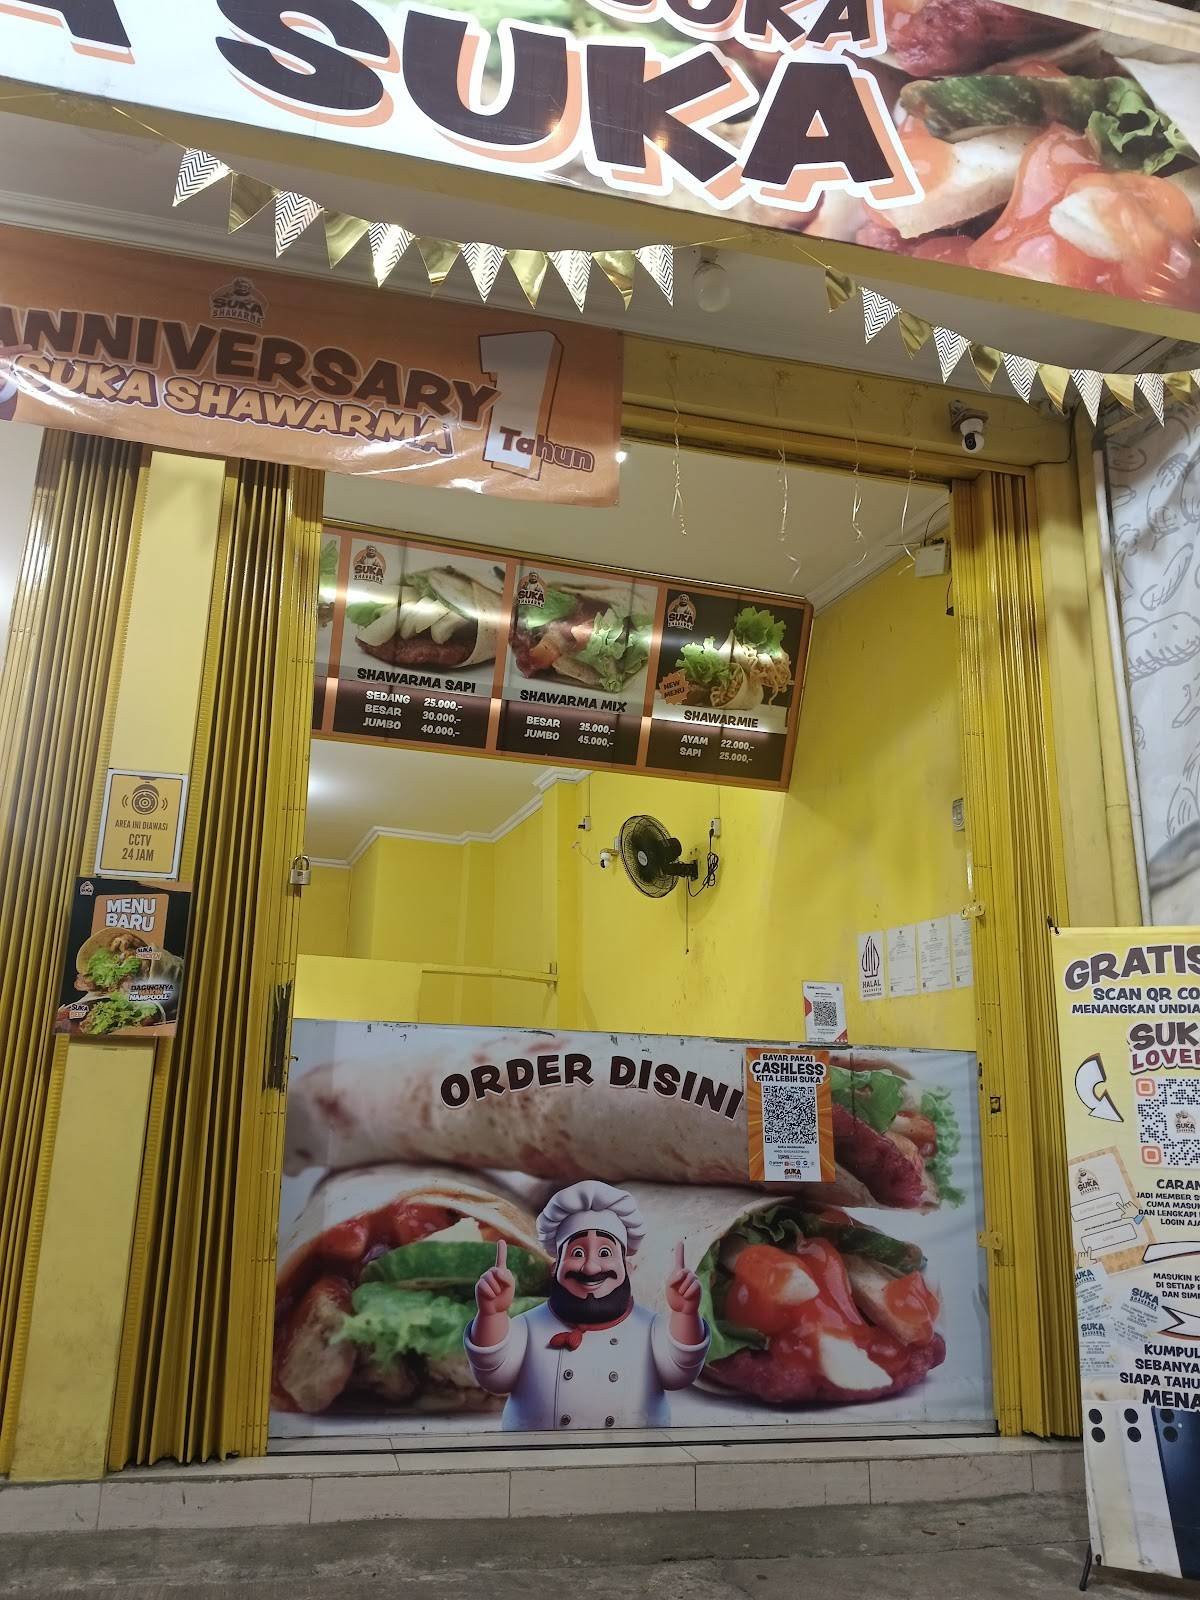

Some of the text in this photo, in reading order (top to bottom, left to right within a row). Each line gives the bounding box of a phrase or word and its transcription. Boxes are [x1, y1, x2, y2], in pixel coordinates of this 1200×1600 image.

[214, 0, 900, 190] SUKA
[212, 297, 264, 316] SUKA
[12, 353, 455, 456] SUKA SHAWARMA
[479, 329, 564, 480] 1
[499, 426, 594, 472] Tahun
[354, 564, 384, 579] SUKA
[517, 590, 544, 603] SUKA
[668, 612, 694, 625] SUKA
[357, 668, 476, 693] SHAWARMA SAPI
[663, 680, 680, 690] NEW
[366, 690, 463, 711] SEDANG 25.000,-
[664, 687, 685, 699] MENU
[519, 689, 628, 713] SHAWARMA MIX
[364, 704, 461, 724] BESAR 30.000,-
[684, 710, 759, 728] SHAWARMIE
[363, 717, 460, 737] JUMBO 40.000,-
[526, 715, 615, 734] BESAR 35.000,-
[524, 728, 614, 748] JUMBO 45.000,-
[681, 734, 755, 752] AYAM 22.000,-
[679, 747, 753, 763] SAPI 25.000,-
[115, 819, 168, 831] AREA INI DIAWASI
[128, 833, 152, 847] CCTV
[121, 848, 154, 861] 24 JAM
[106, 898, 156, 915] MENU
[105, 913, 155, 932] BARU
[862, 980, 882, 989] HALAL
[1093, 987, 1142, 1001] SCAN
[1146, 987, 1172, 1002] QR
[1072, 1004, 1156, 1014] MENANGKAN
[762, 1054, 813, 1063] BAYAR PAKAI
[751, 1061, 825, 1076] CASHLESS
[756, 1074, 821, 1084] KITA LEBIH SUKA
[440, 1053, 744, 1121] ORDER DISINI
[1077, 1179, 1099, 1192] SUKA
[1138, 1208, 1156, 1216] DAN
[1157, 1210, 1197, 1218] LENGKAPI
[1160, 1218, 1185, 1226] LOGIN
[1153, 1272, 1192, 1281] MASUKIN
[1166, 1282, 1195, 1290] SETIAP
[1131, 1287, 1159, 1306] SUKA
[1162, 1290, 1179, 1298] DAN
[1081, 1322, 1106, 1332] SUKA
[1119, 1371, 1161, 1386] SIAPA
